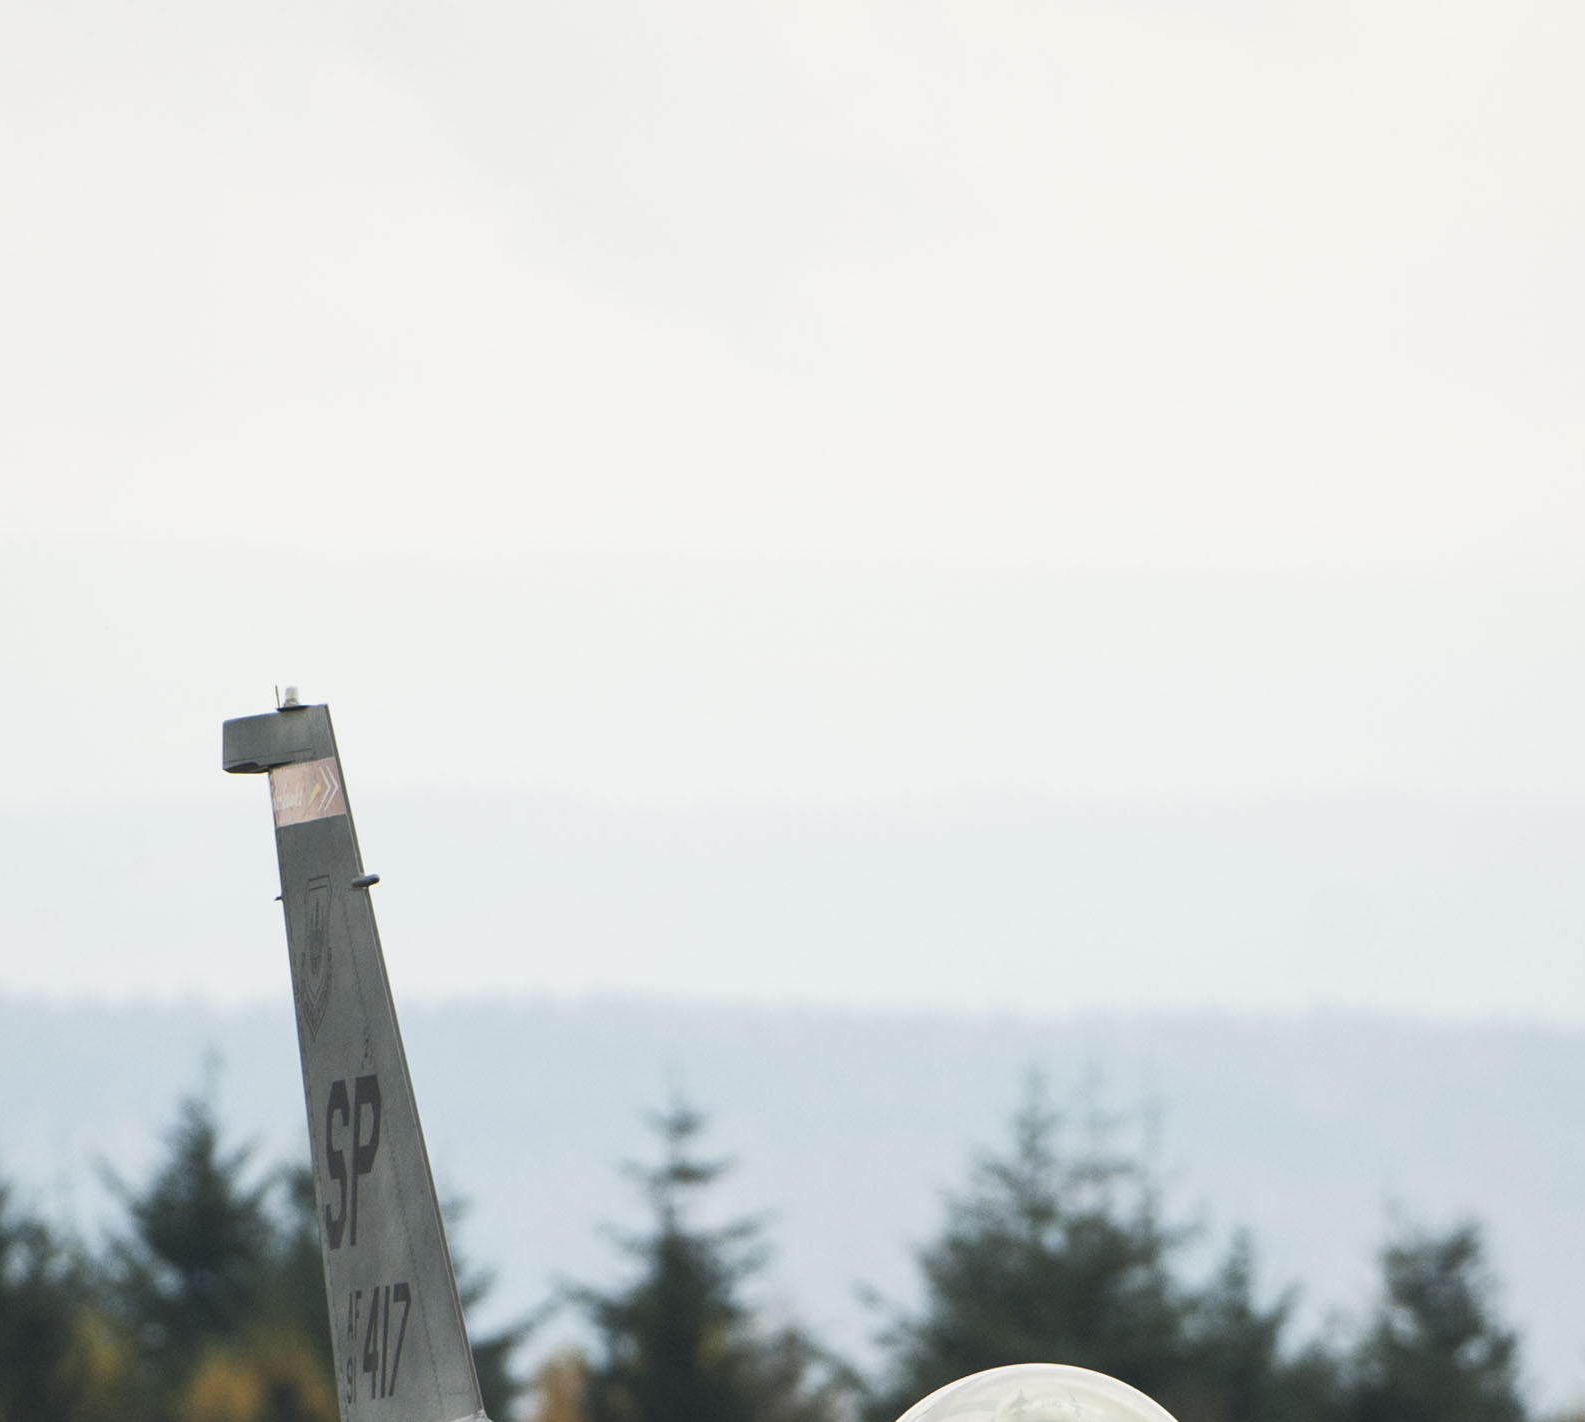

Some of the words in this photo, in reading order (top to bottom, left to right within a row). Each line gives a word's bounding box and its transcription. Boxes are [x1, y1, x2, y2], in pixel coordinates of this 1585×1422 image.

[325, 1073, 382, 1251] SP
[347, 1290, 362, 1341] AF
[363, 1282, 412, 1400] 417
[346, 1355, 357, 1405] 91
